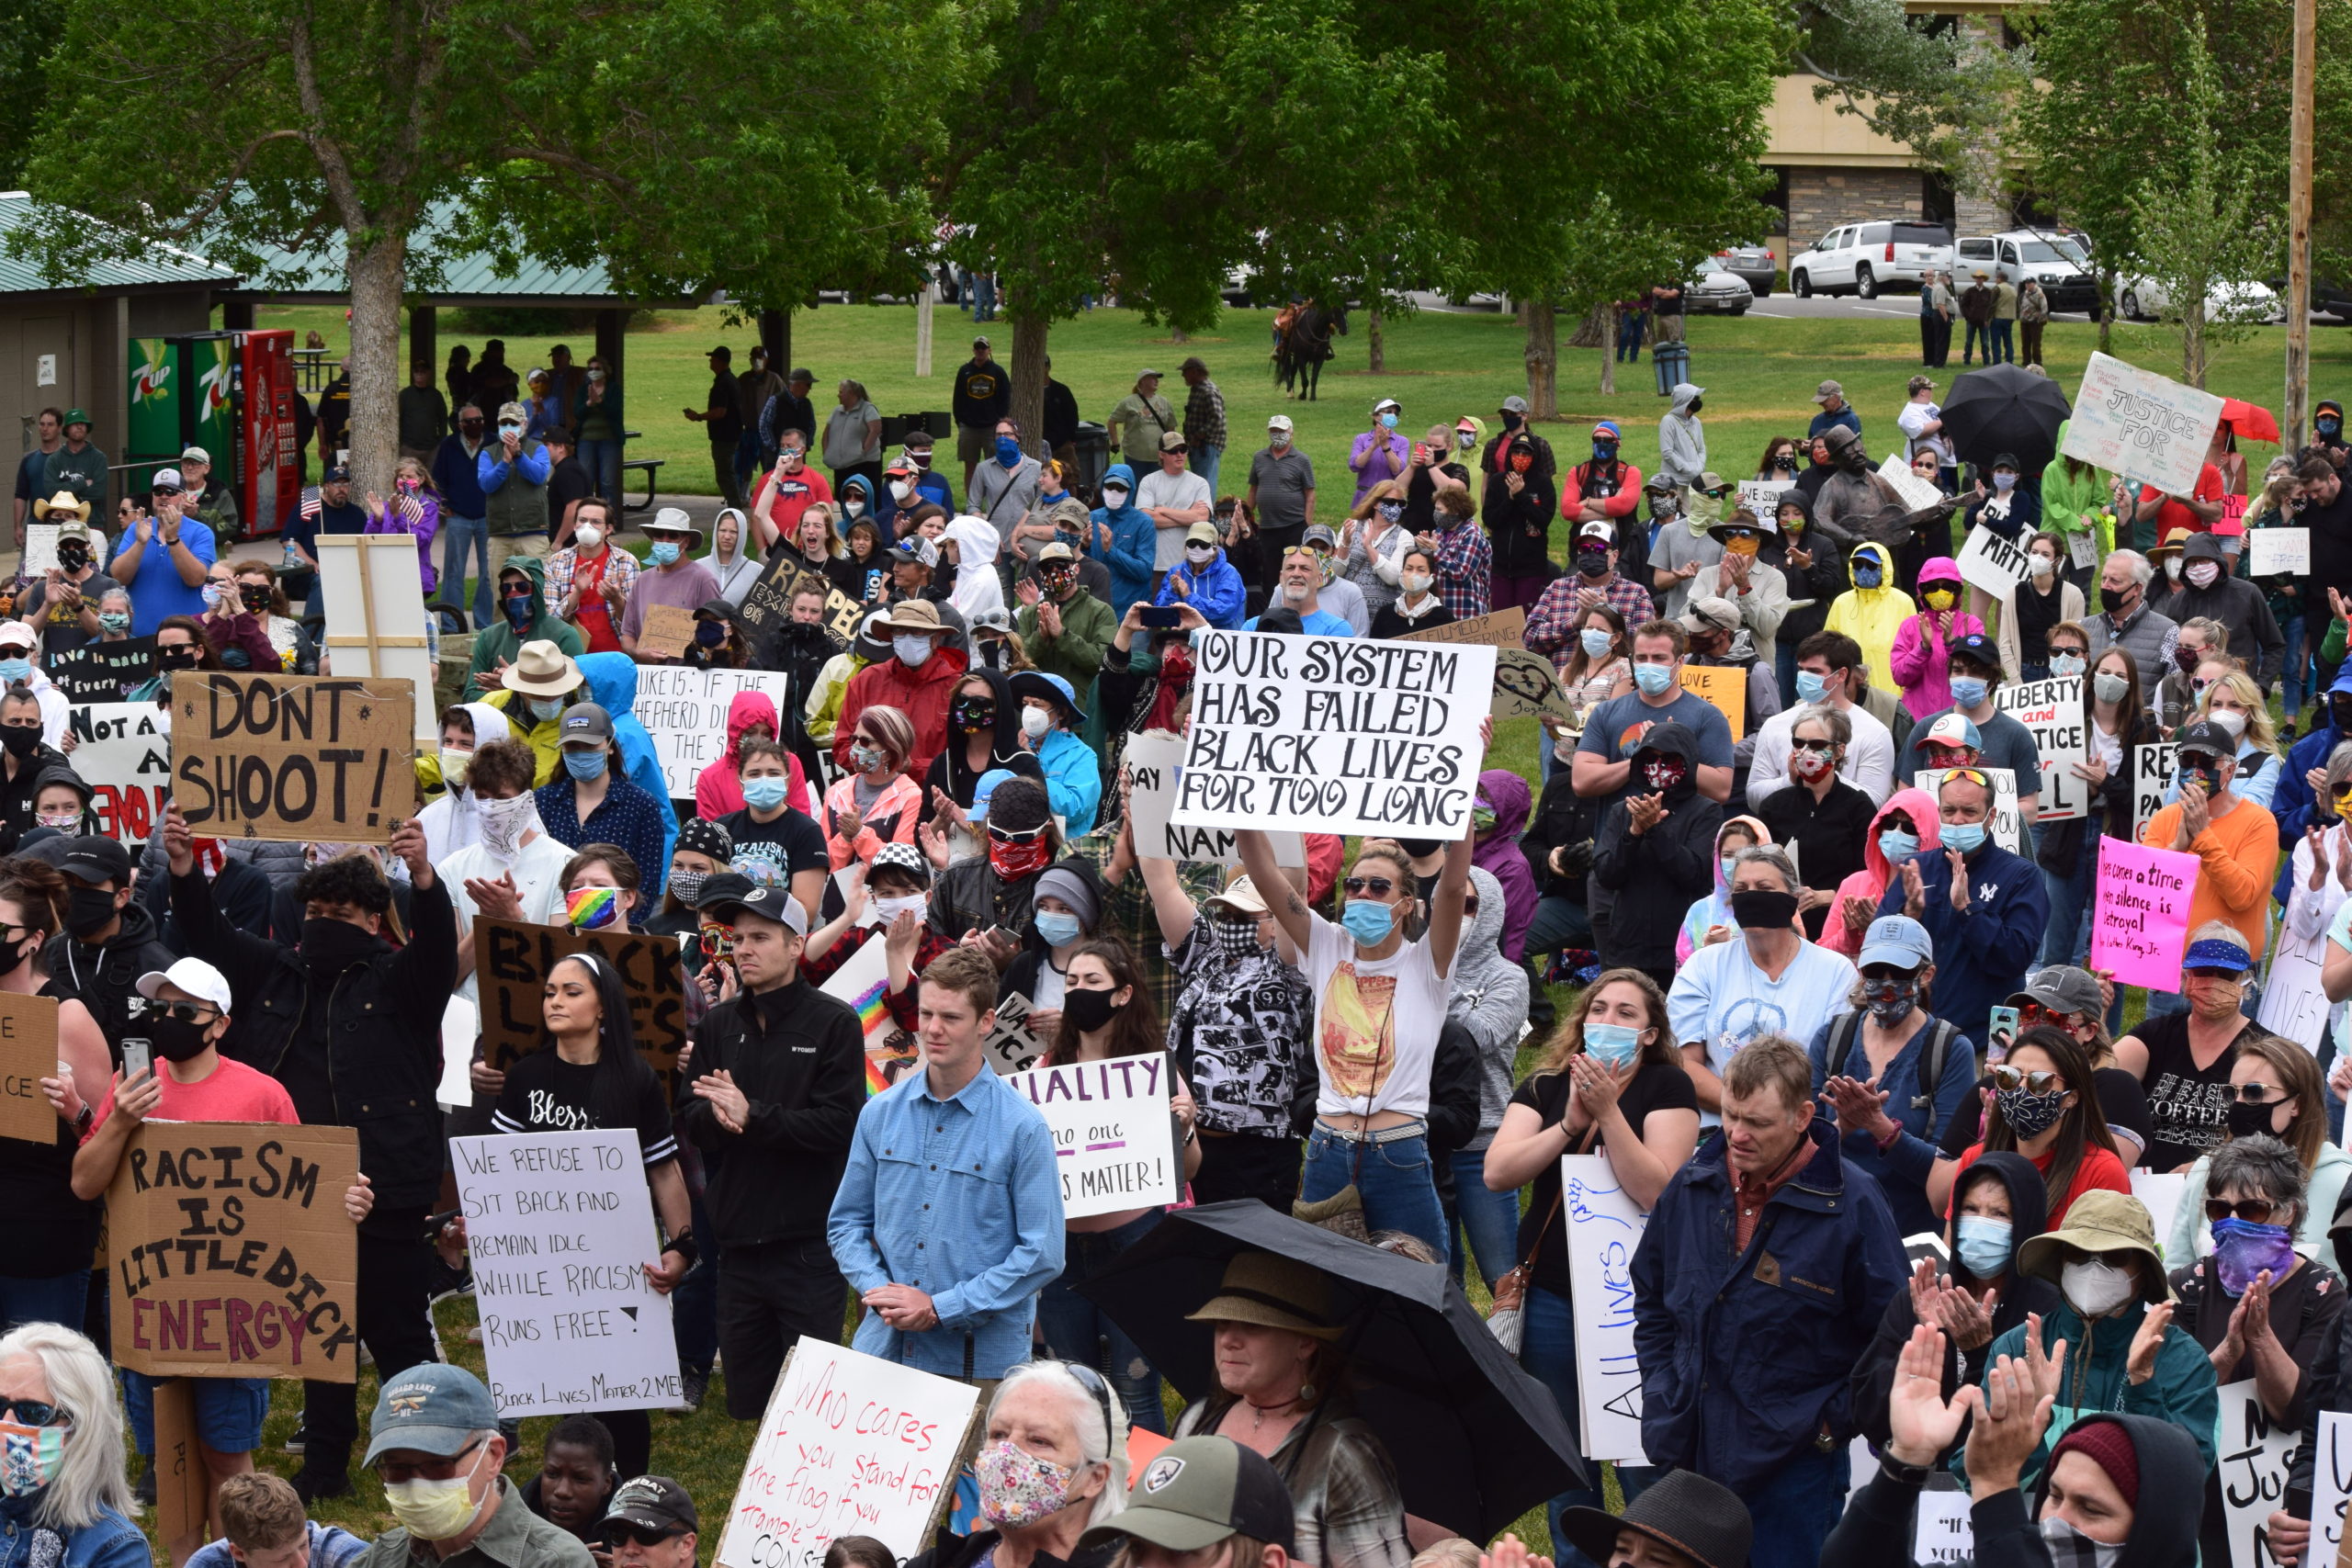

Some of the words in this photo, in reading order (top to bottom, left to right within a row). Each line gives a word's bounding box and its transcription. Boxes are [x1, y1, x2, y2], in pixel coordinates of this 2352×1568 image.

[2107, 389, 2199, 440] JUSTICE
[2120, 419, 2171, 457] FOR
[1742, 487, 1758, 502] WE
[2271, 554, 2304, 569] FREE
[743, 603, 765, 626] OR
[1201, 632, 1288, 680] OUR
[1299, 640, 1459, 694] SYSTEM
[704, 673, 723, 698] IF
[734, 674, 768, 693] THE
[1679, 672, 1712, 688] LOVE
[1996, 677, 2081, 711] LIBERTY
[633, 701, 699, 729] HEPHERD
[1196, 683, 1282, 728] HAS
[1303, 690, 1449, 737] FAILED
[2023, 705, 2055, 723] and
[674, 734, 707, 761] THE
[2033, 727, 2082, 750] TICE
[1186, 728, 1320, 775] BLACK
[1340, 738, 1463, 785] LIVES
[1127, 761, 1160, 791] SAY
[1179, 773, 1255, 814] FOR
[1268, 777, 1348, 817] TOO
[1356, 783, 1469, 827] LONG
[748, 841, 788, 862] ALASKA
[1165, 822, 1242, 860] NAM
[2113, 863, 2132, 880] comes
[2136, 872, 2145, 884] a
[2148, 863, 2184, 890] time
[2116, 884, 2151, 911] silence
[2161, 897, 2172, 914] is
[1, 1075, 33, 1099] CE
[1011, 1058, 1160, 1105] UALITY
[1089, 1122, 1124, 1142] one
[458, 1141, 501, 1175] WE
[510, 1146, 584, 1172] REFUSE
[593, 1145, 623, 1171] TO
[130, 1140, 321, 1209] RACISM
[177, 1195, 245, 1236] IS
[463, 1187, 503, 1218] SIT
[516, 1190, 570, 1215] BACK
[577, 1191, 620, 1213] AND
[469, 1235, 537, 1259] REMAIN
[548, 1234, 591, 1254] IDLE
[476, 1269, 553, 1296] WHILE
[563, 1261, 649, 1296] RACISM
[120, 1237, 269, 1299] LITTLE
[263, 1246, 356, 1361] DICK
[132, 1297, 310, 1366] ENERGY
[484, 1314, 541, 1348] RUNS
[415, 1383, 436, 1394] LAKE
[642, 1377, 655, 1398] 2
[655, 1375, 684, 1397] ME!
[795, 1360, 847, 1430] Who
[856, 1401, 938, 1451] cares
[765, 1410, 794, 1458] if
[798, 1443, 835, 1471] you
[908, 1469, 940, 1506] for
[616, 1478, 667, 1496] COMBAT
[749, 1459, 776, 1495] the
[786, 1467, 829, 1529] flag
[836, 1483, 859, 1520] if
[848, 1503, 881, 1534] you
[1931, 1548, 1961, 1562] you
